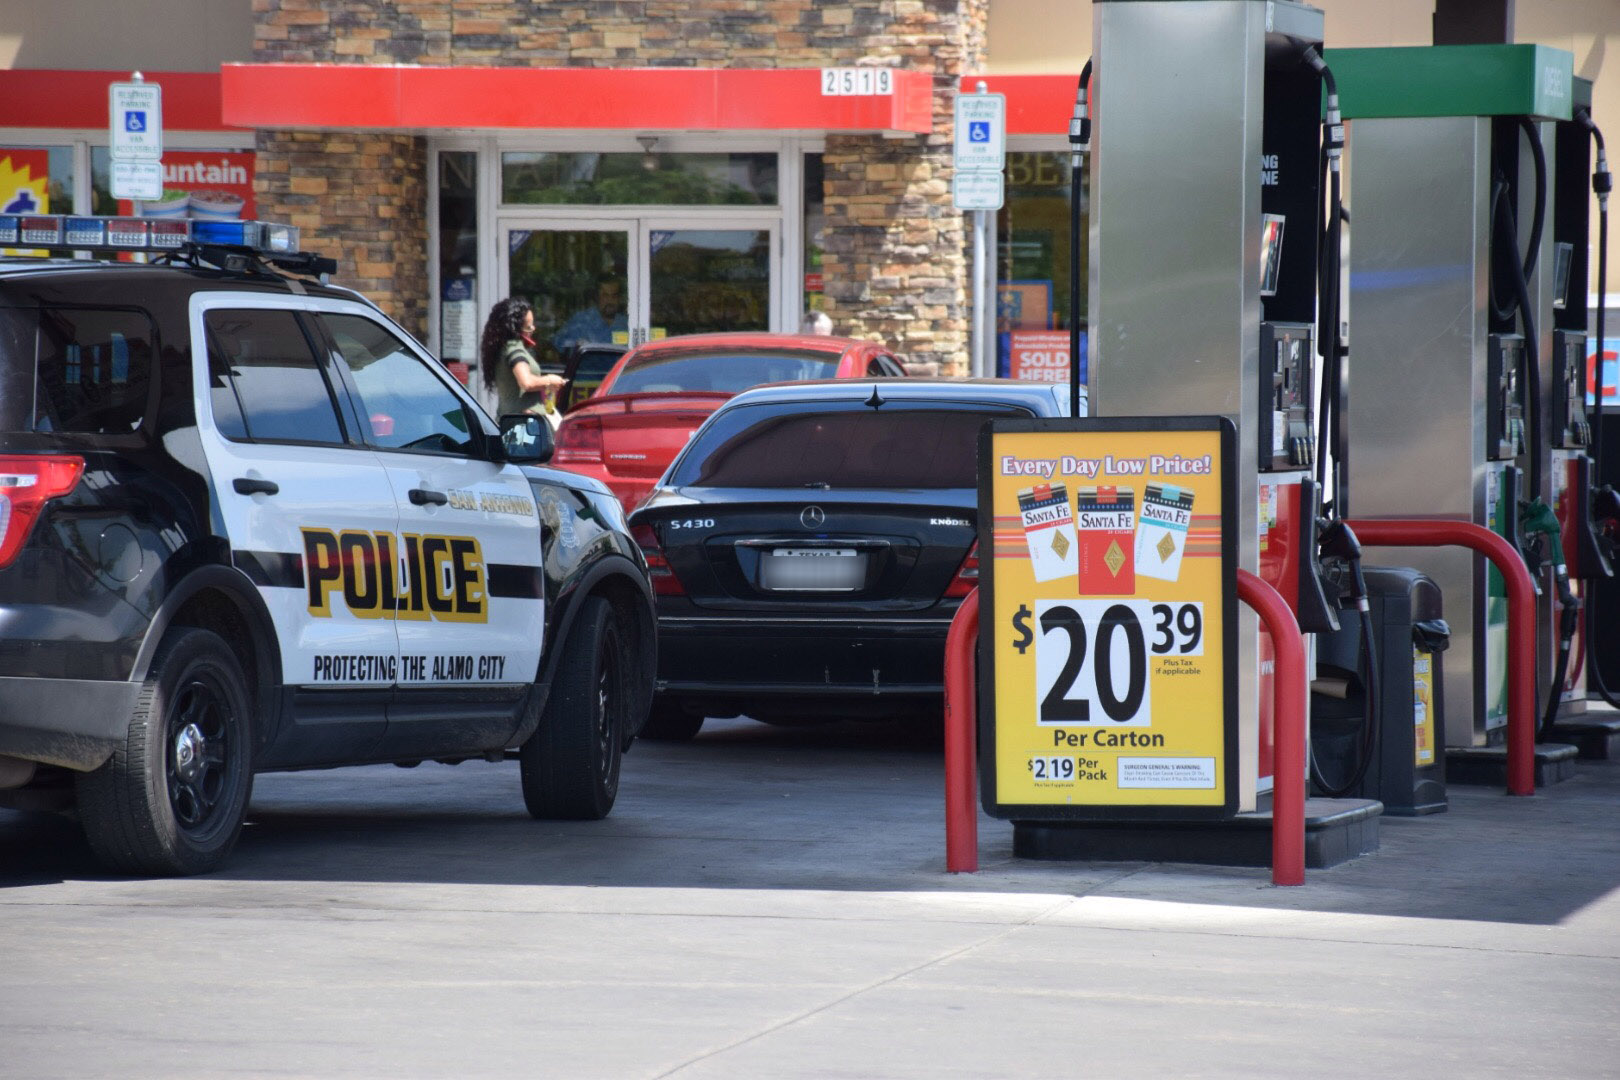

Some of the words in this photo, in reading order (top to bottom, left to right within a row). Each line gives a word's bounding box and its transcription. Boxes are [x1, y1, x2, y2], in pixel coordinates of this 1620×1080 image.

[826, 71, 889, 92] 2519
[1020, 351, 1069, 367] SOLD
[1001, 456, 1057, 478] Every
[1061, 456, 1100, 478] Day
[1104, 456, 1146, 475] Low
[1150, 455, 1212, 475] Price!
[448, 489, 478, 511] SAN
[479, 492, 533, 516] ANTONIO
[1025, 511, 1056, 525] SANTA
[1056, 504, 1070, 518] FE
[1081, 513, 1115, 528] SANTA
[1117, 513, 1132, 528] FE
[1143, 504, 1175, 521] SANTA
[1175, 510, 1188, 524] FE
[300, 526, 488, 624] POLICE
[313, 655, 396, 681] PROTECTING
[401, 655, 426, 681] THE
[431, 655, 473, 681] ALAMO
[478, 655, 506, 680] CITY
[1162, 667, 1201, 676] applicable
[1054, 730, 1088, 747] Per
[1093, 730, 1164, 747] Carton
[1078, 758, 1098, 768] Per
[1079, 769, 1107, 780] Pack
